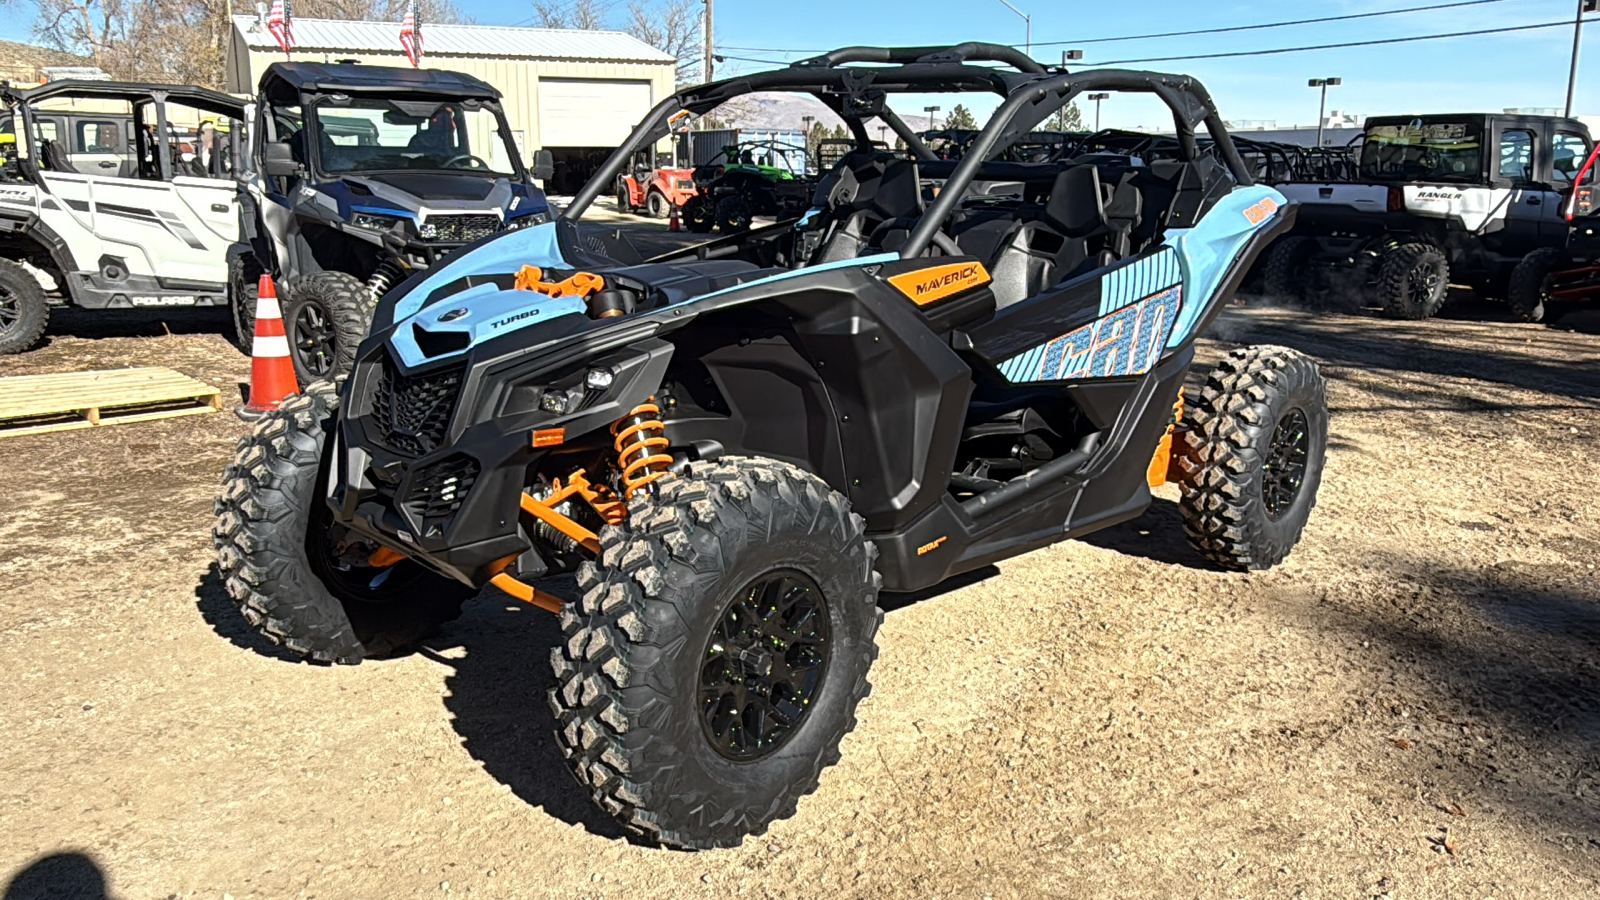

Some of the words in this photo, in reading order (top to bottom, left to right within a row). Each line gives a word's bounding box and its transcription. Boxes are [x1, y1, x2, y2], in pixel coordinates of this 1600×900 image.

[1417, 191, 1462, 199] RANGER
[916, 265, 978, 295] MAVERICK
[132, 296, 195, 306] POLARIS
[491, 309, 540, 329] TURBO
